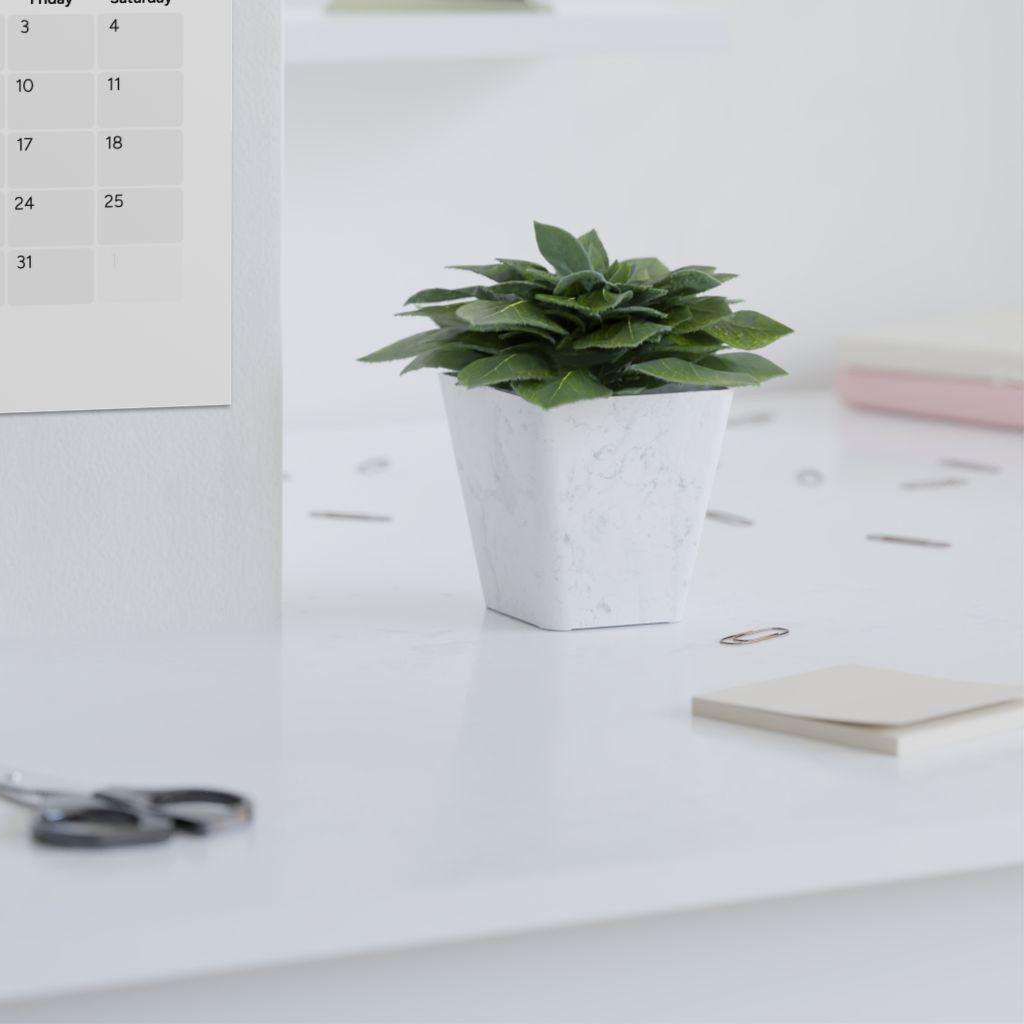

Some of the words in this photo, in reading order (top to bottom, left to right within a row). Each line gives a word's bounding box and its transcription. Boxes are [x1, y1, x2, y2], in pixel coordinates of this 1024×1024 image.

[20, 19, 30, 34] 3
[108, 18, 120, 33] 4
[15, 78, 34, 93] 10
[107, 76, 120, 91] 11
[16, 137, 34, 152] 17
[105, 135, 123, 150] 18
[14, 196, 36, 211] 24
[104, 193, 124, 209] 25
[16, 254, 32, 270] 31
